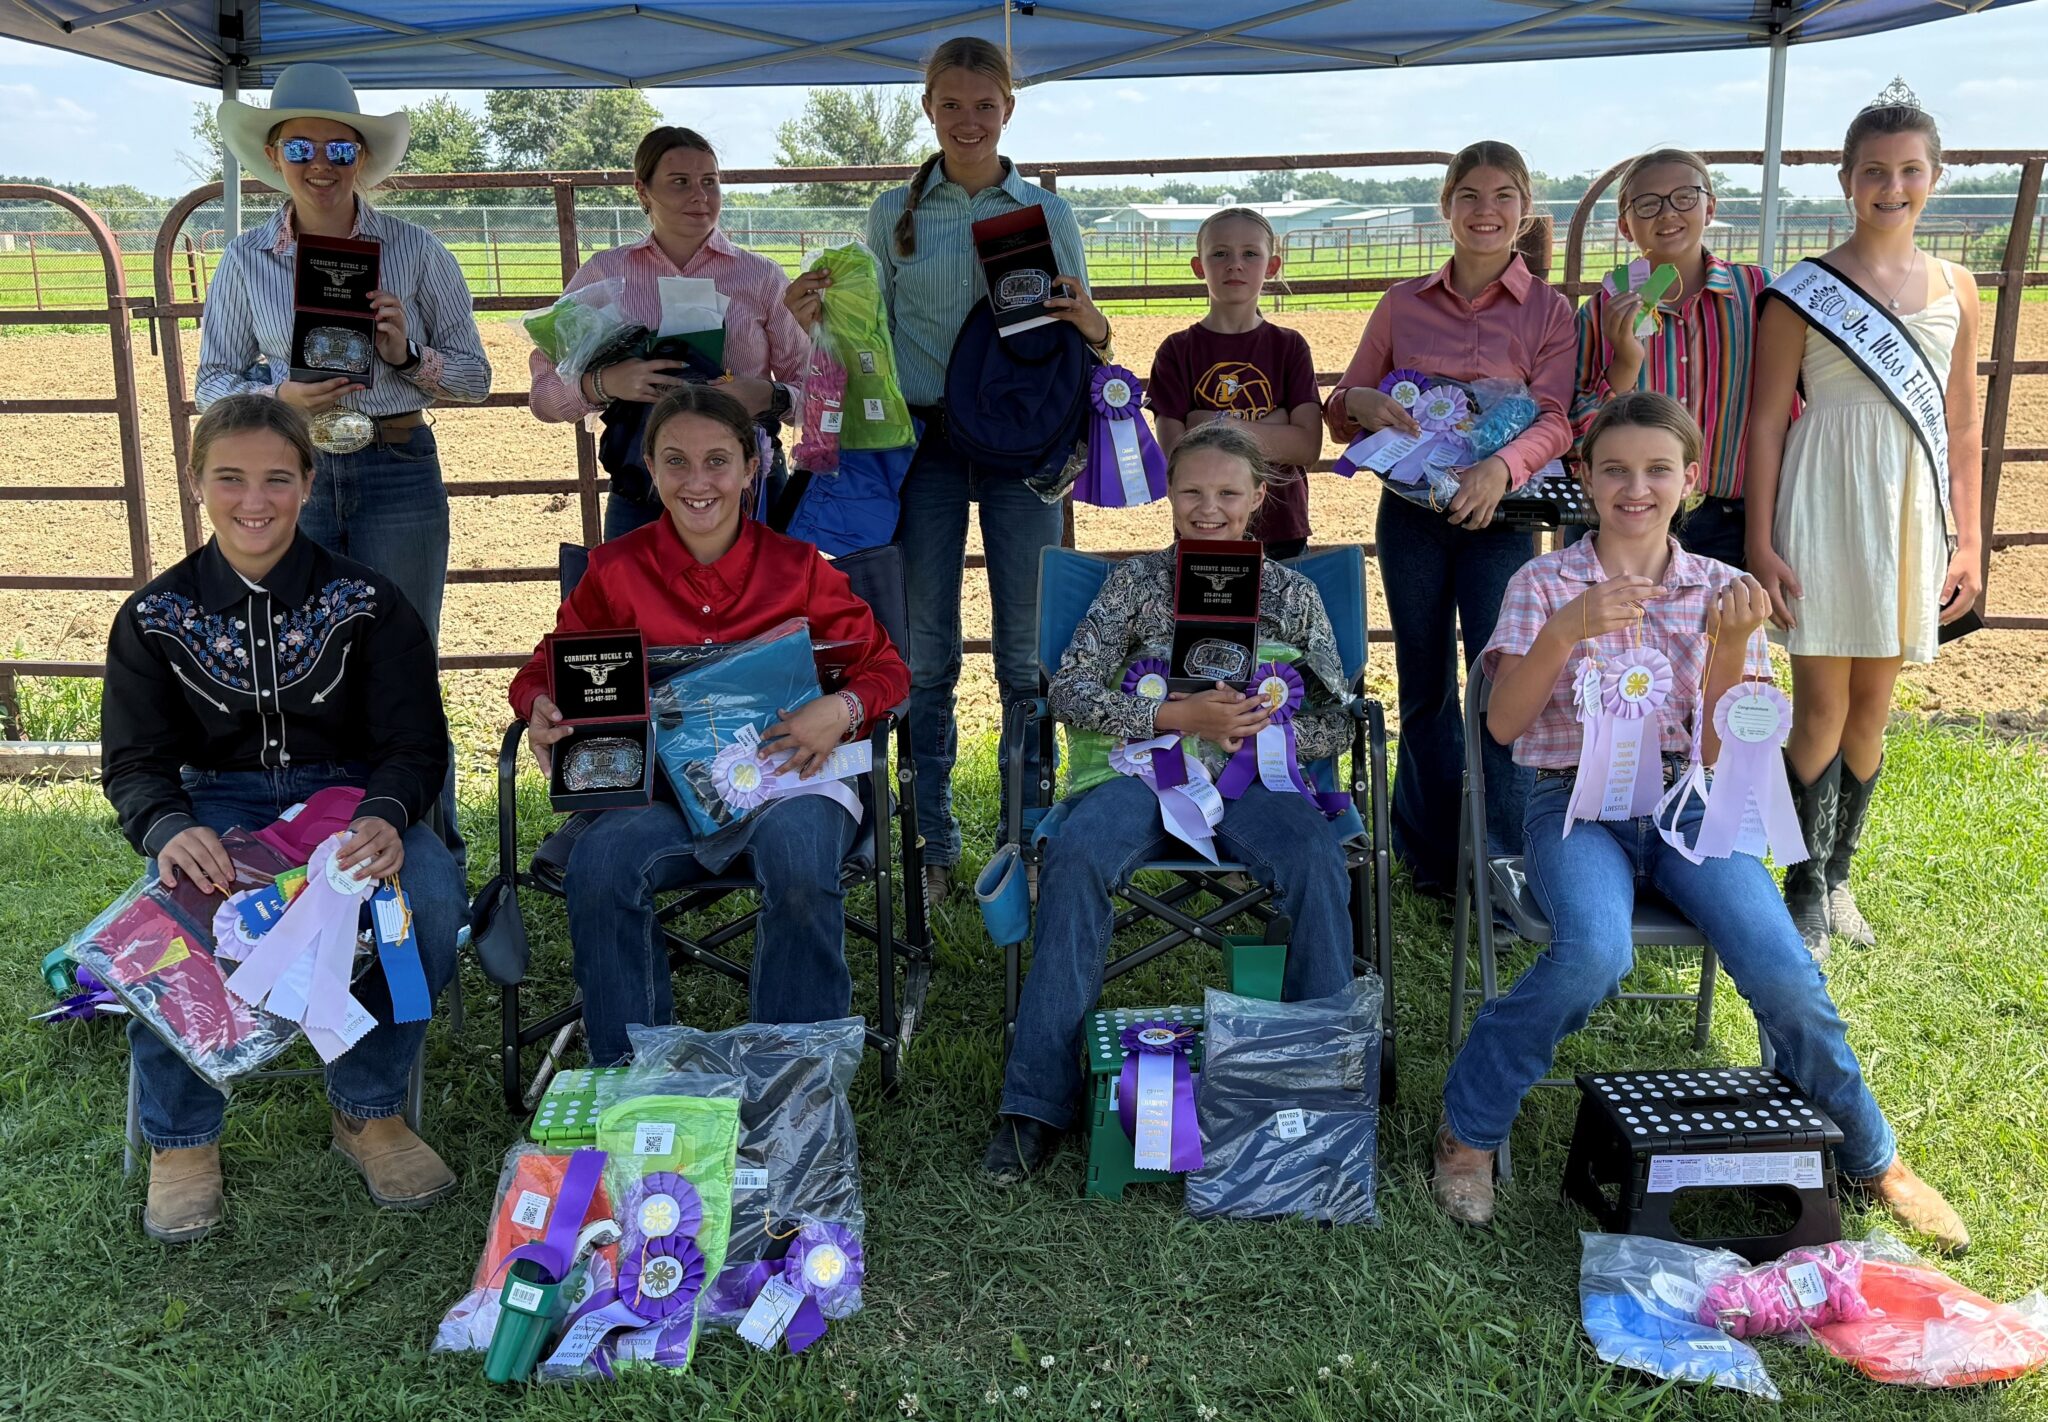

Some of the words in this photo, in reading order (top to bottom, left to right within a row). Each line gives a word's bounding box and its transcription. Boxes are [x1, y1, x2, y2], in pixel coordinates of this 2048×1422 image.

[1790, 273, 1818, 296] 2025
[1842, 314, 1868, 344] Jr.
[1869, 332, 1905, 377] Miss
[1903, 370, 1942, 450] Effingham
[564, 654, 597, 663] CORRIENTE
[600, 652, 622, 661] BUCKLE
[624, 651, 633, 659] CO.
[254, 900, 272, 921] EXHIBIT
[270, 899, 281, 911] 4-H
[342, 1013, 368, 1036] LIVESTOCK
[621, 1338, 652, 1346] LIVESTOCK
